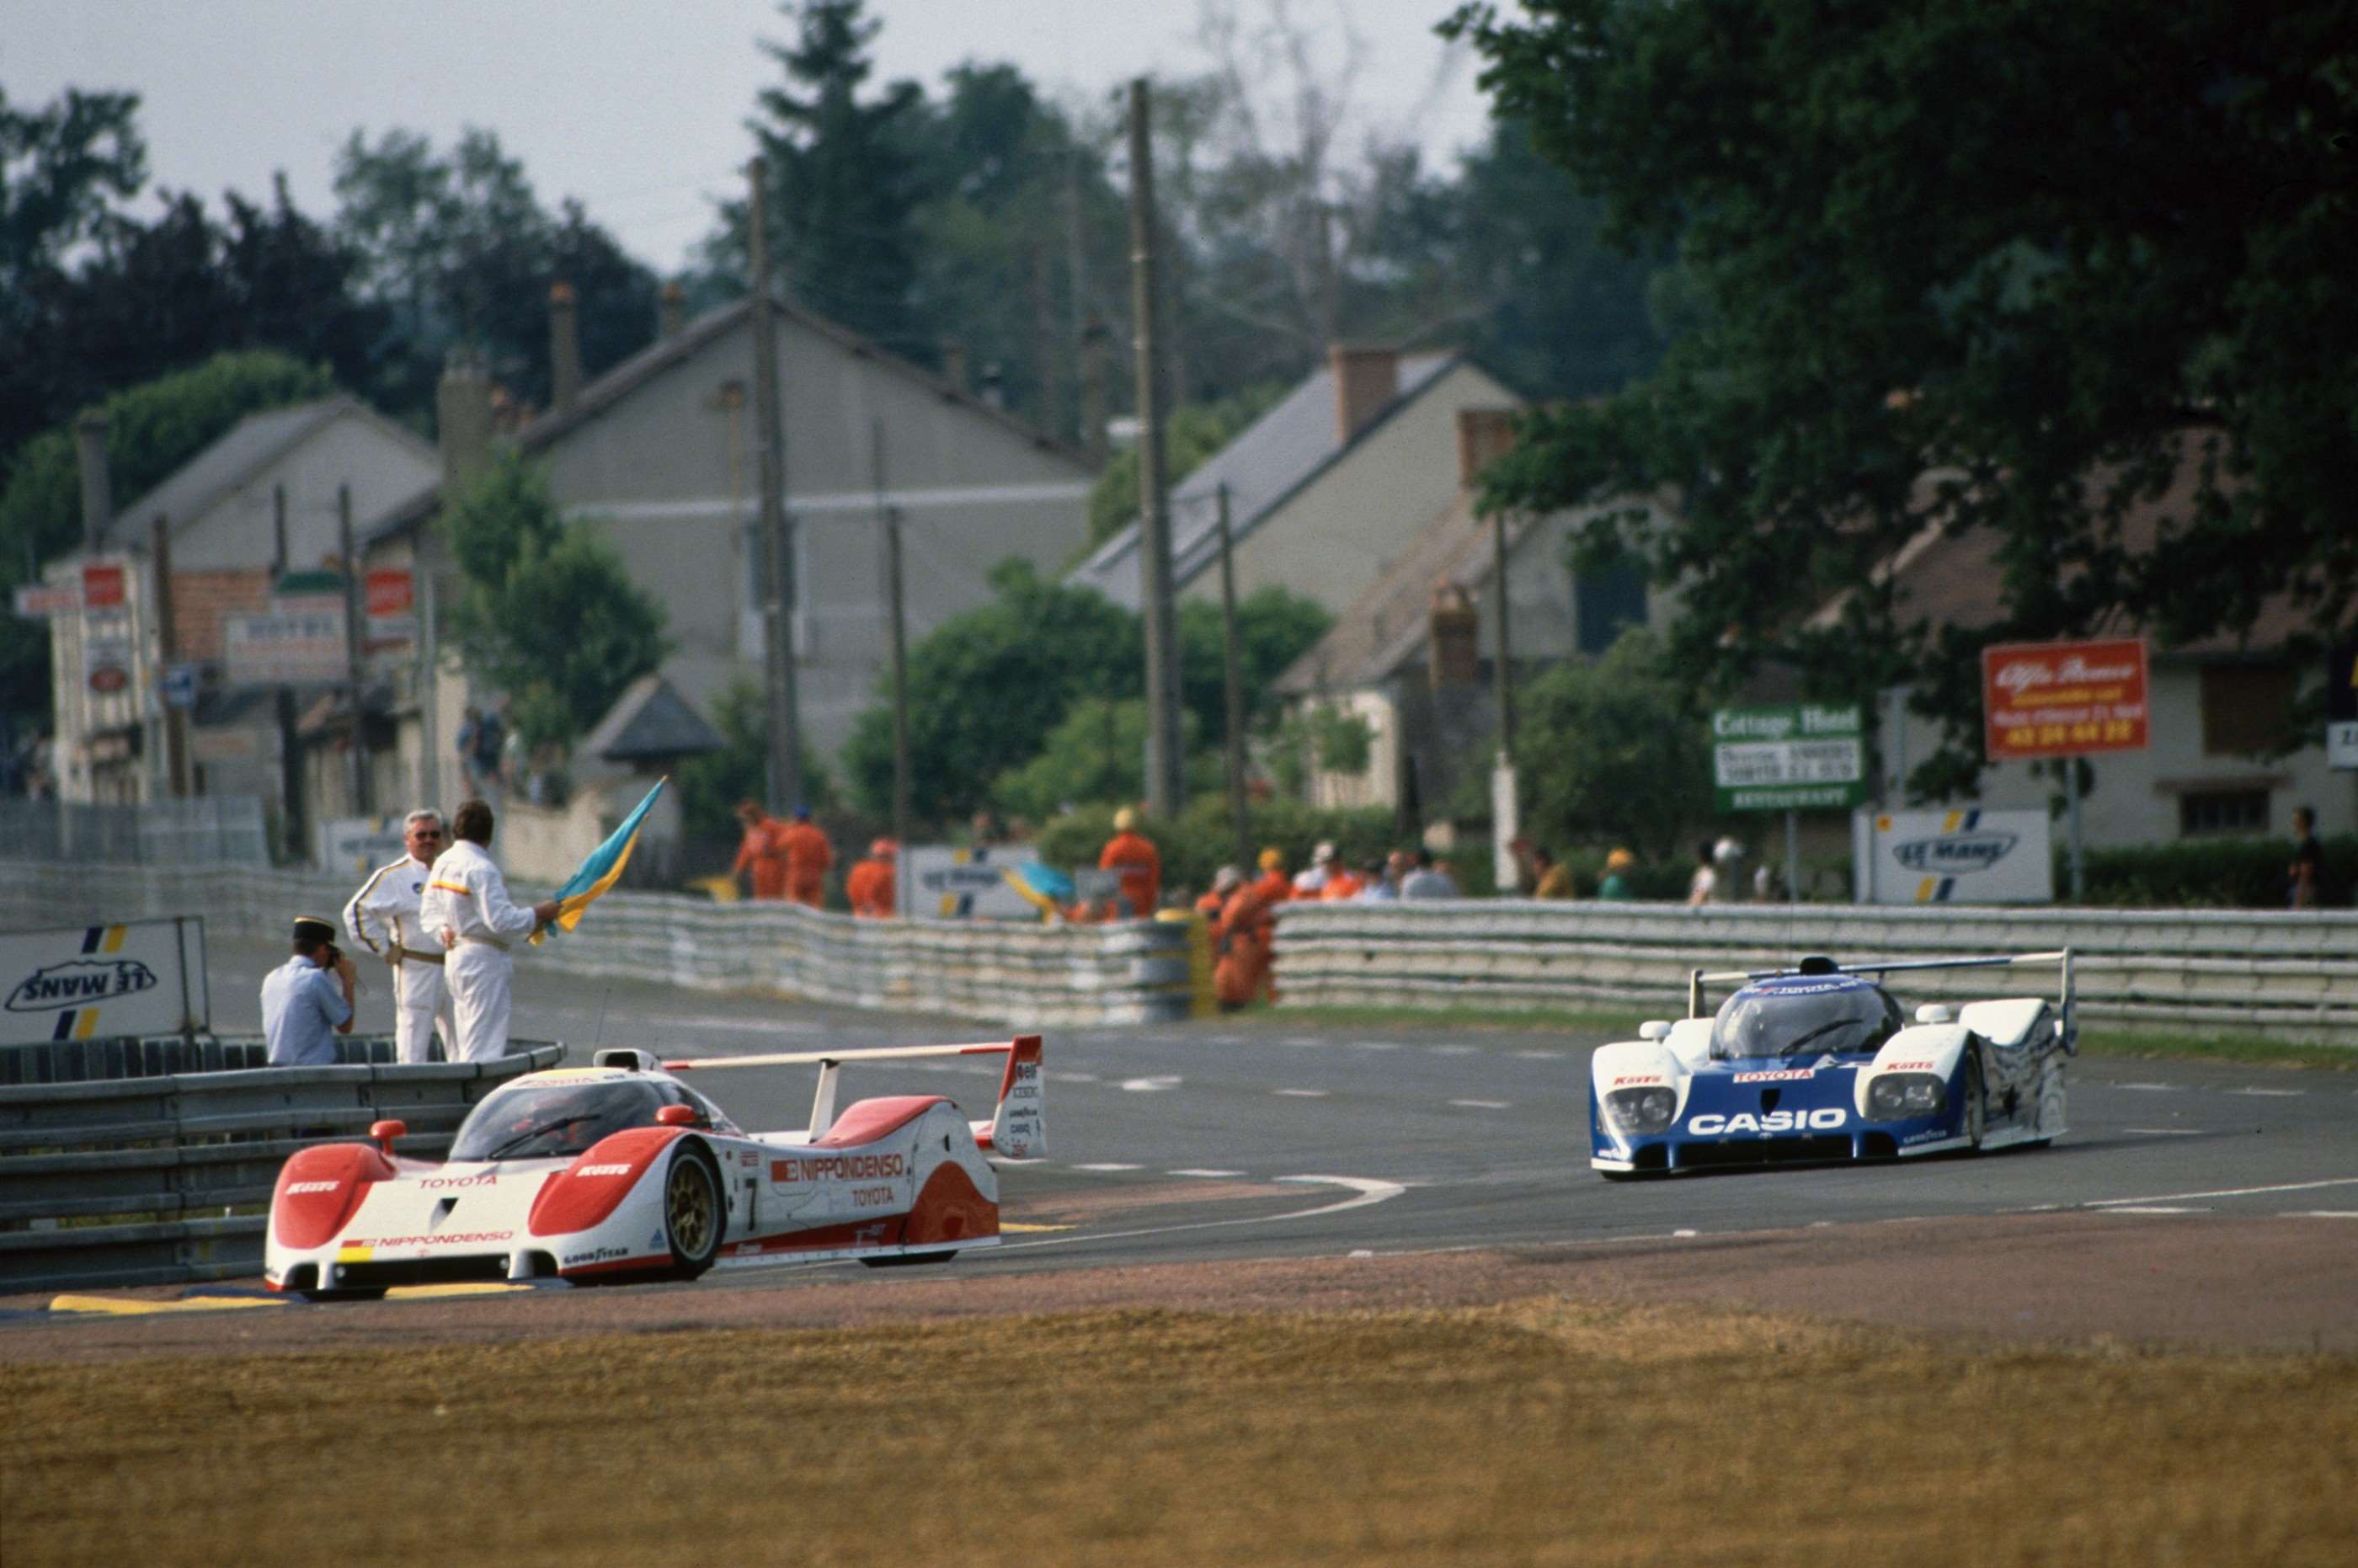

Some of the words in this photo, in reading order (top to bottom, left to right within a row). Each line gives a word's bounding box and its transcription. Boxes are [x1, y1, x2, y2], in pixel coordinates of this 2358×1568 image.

[1902, 842, 1926, 866] LE
[1934, 840, 2002, 863] MANS
[24, 973, 109, 1000] MANS
[116, 966, 144, 994] LE
[1736, 1069, 1811, 1082] TOYOTA
[1688, 1107, 1847, 1136] CASIO
[799, 1154, 903, 1180] NIPPONDENSO
[419, 1175, 498, 1189] TOYOTA
[745, 1178, 757, 1231] 7
[851, 1186, 894, 1208] TOYOTA
[379, 1230, 514, 1248] NIPPONDENSO
